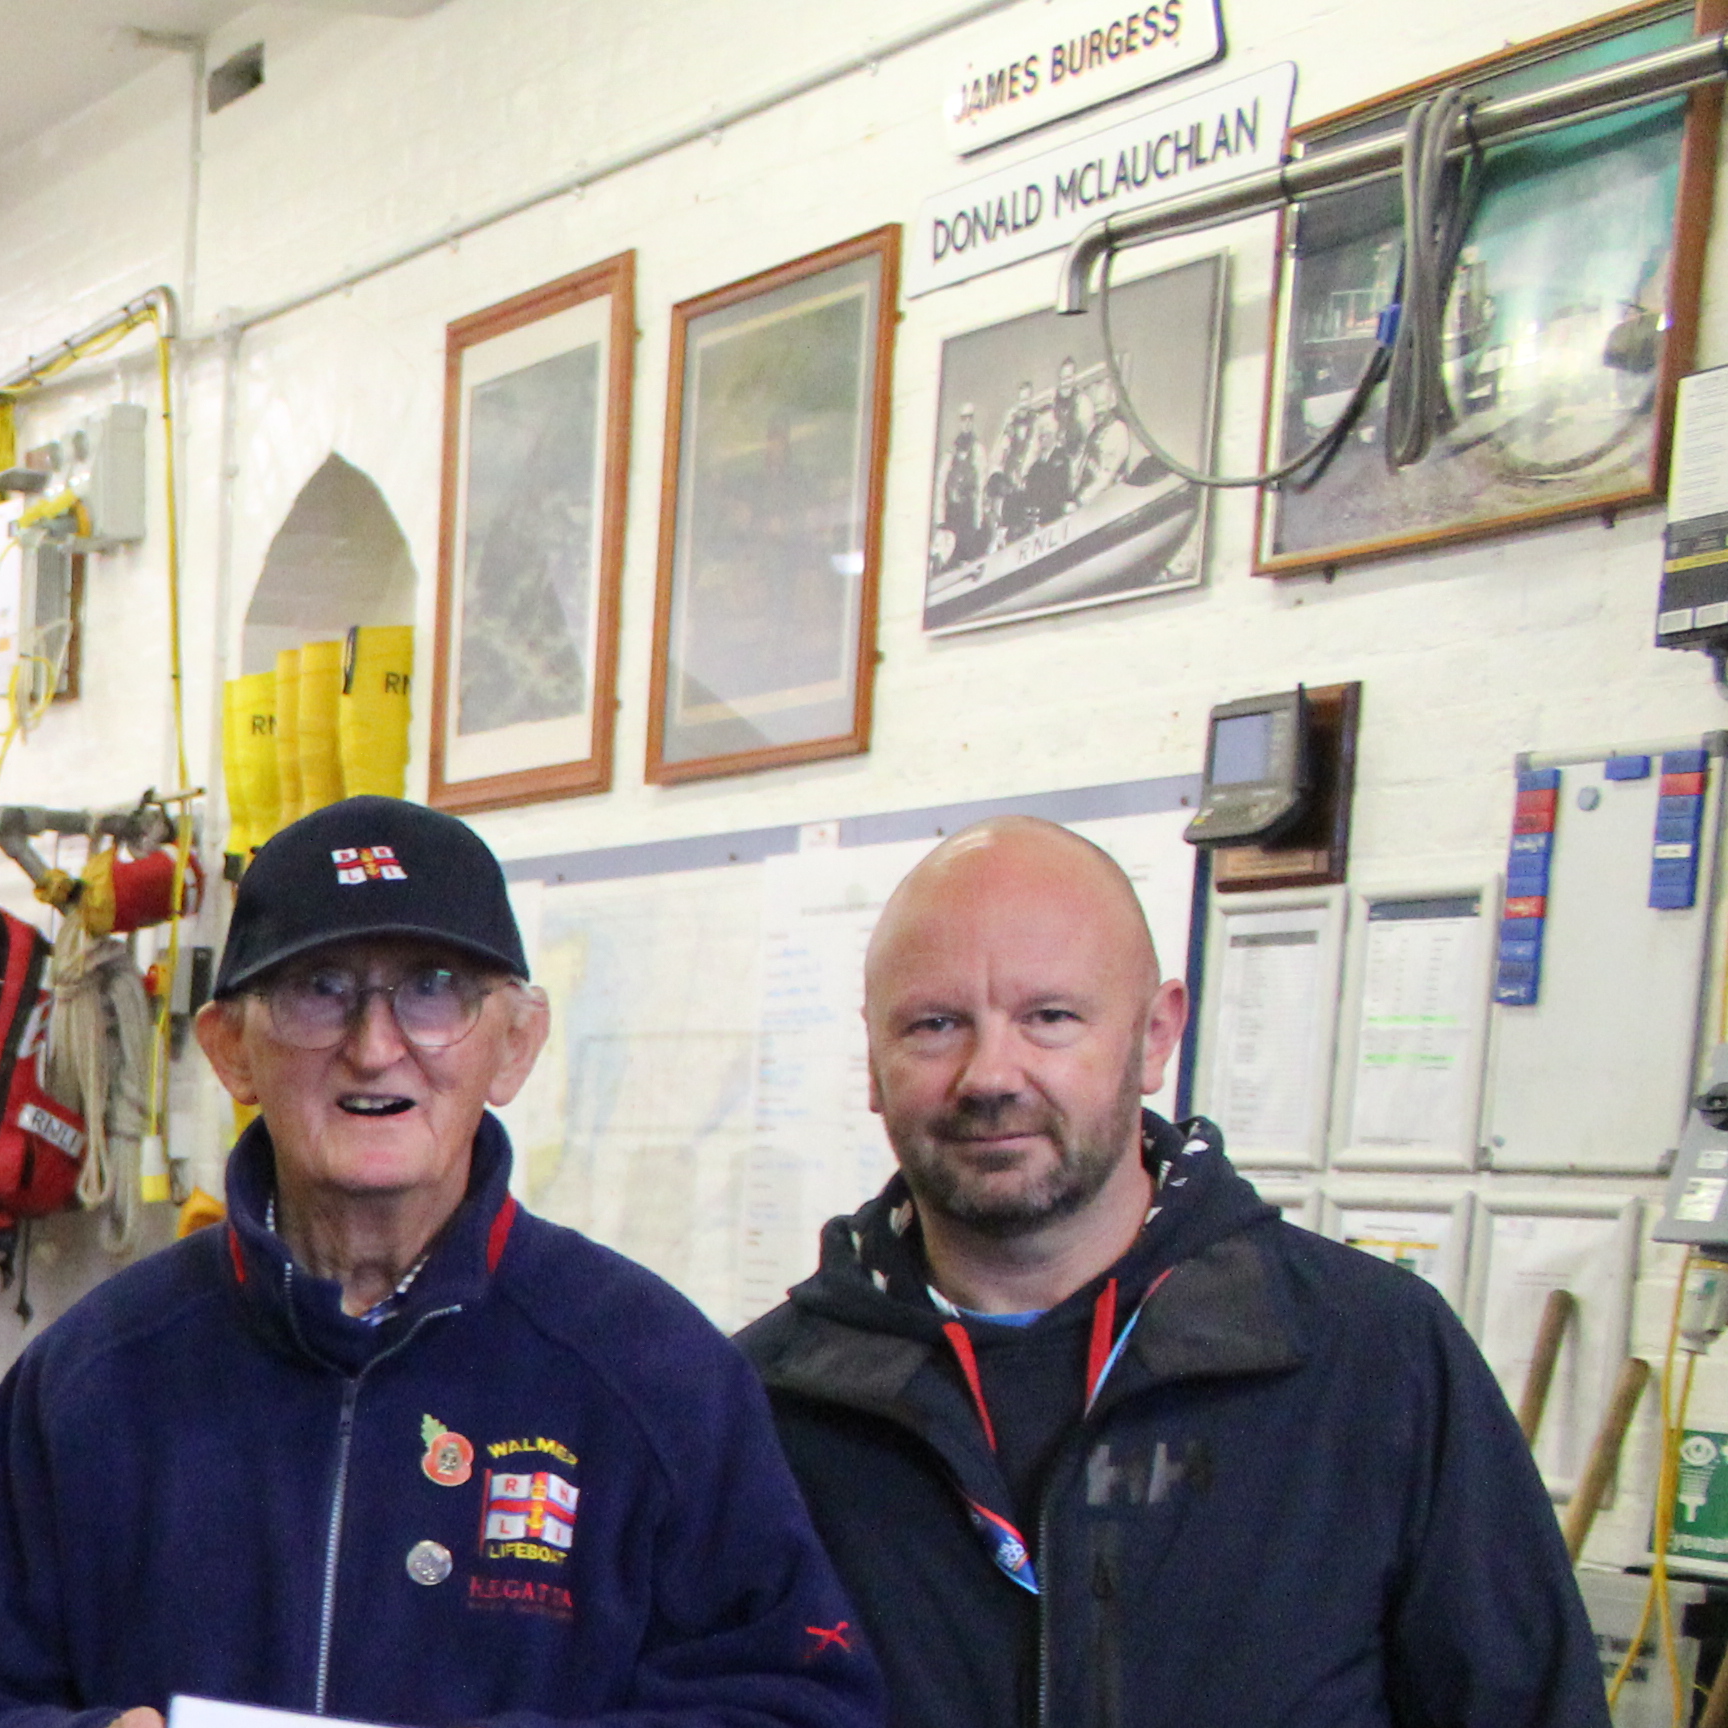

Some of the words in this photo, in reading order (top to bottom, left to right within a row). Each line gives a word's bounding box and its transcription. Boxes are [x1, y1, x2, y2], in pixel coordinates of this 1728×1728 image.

[954, 55, 1039, 123] JAMES
[1050, 0, 1181, 84] BURGESS
[933, 183, 1042, 264] DONALD
[1055, 96, 1259, 218] MCLAUCHLAN
